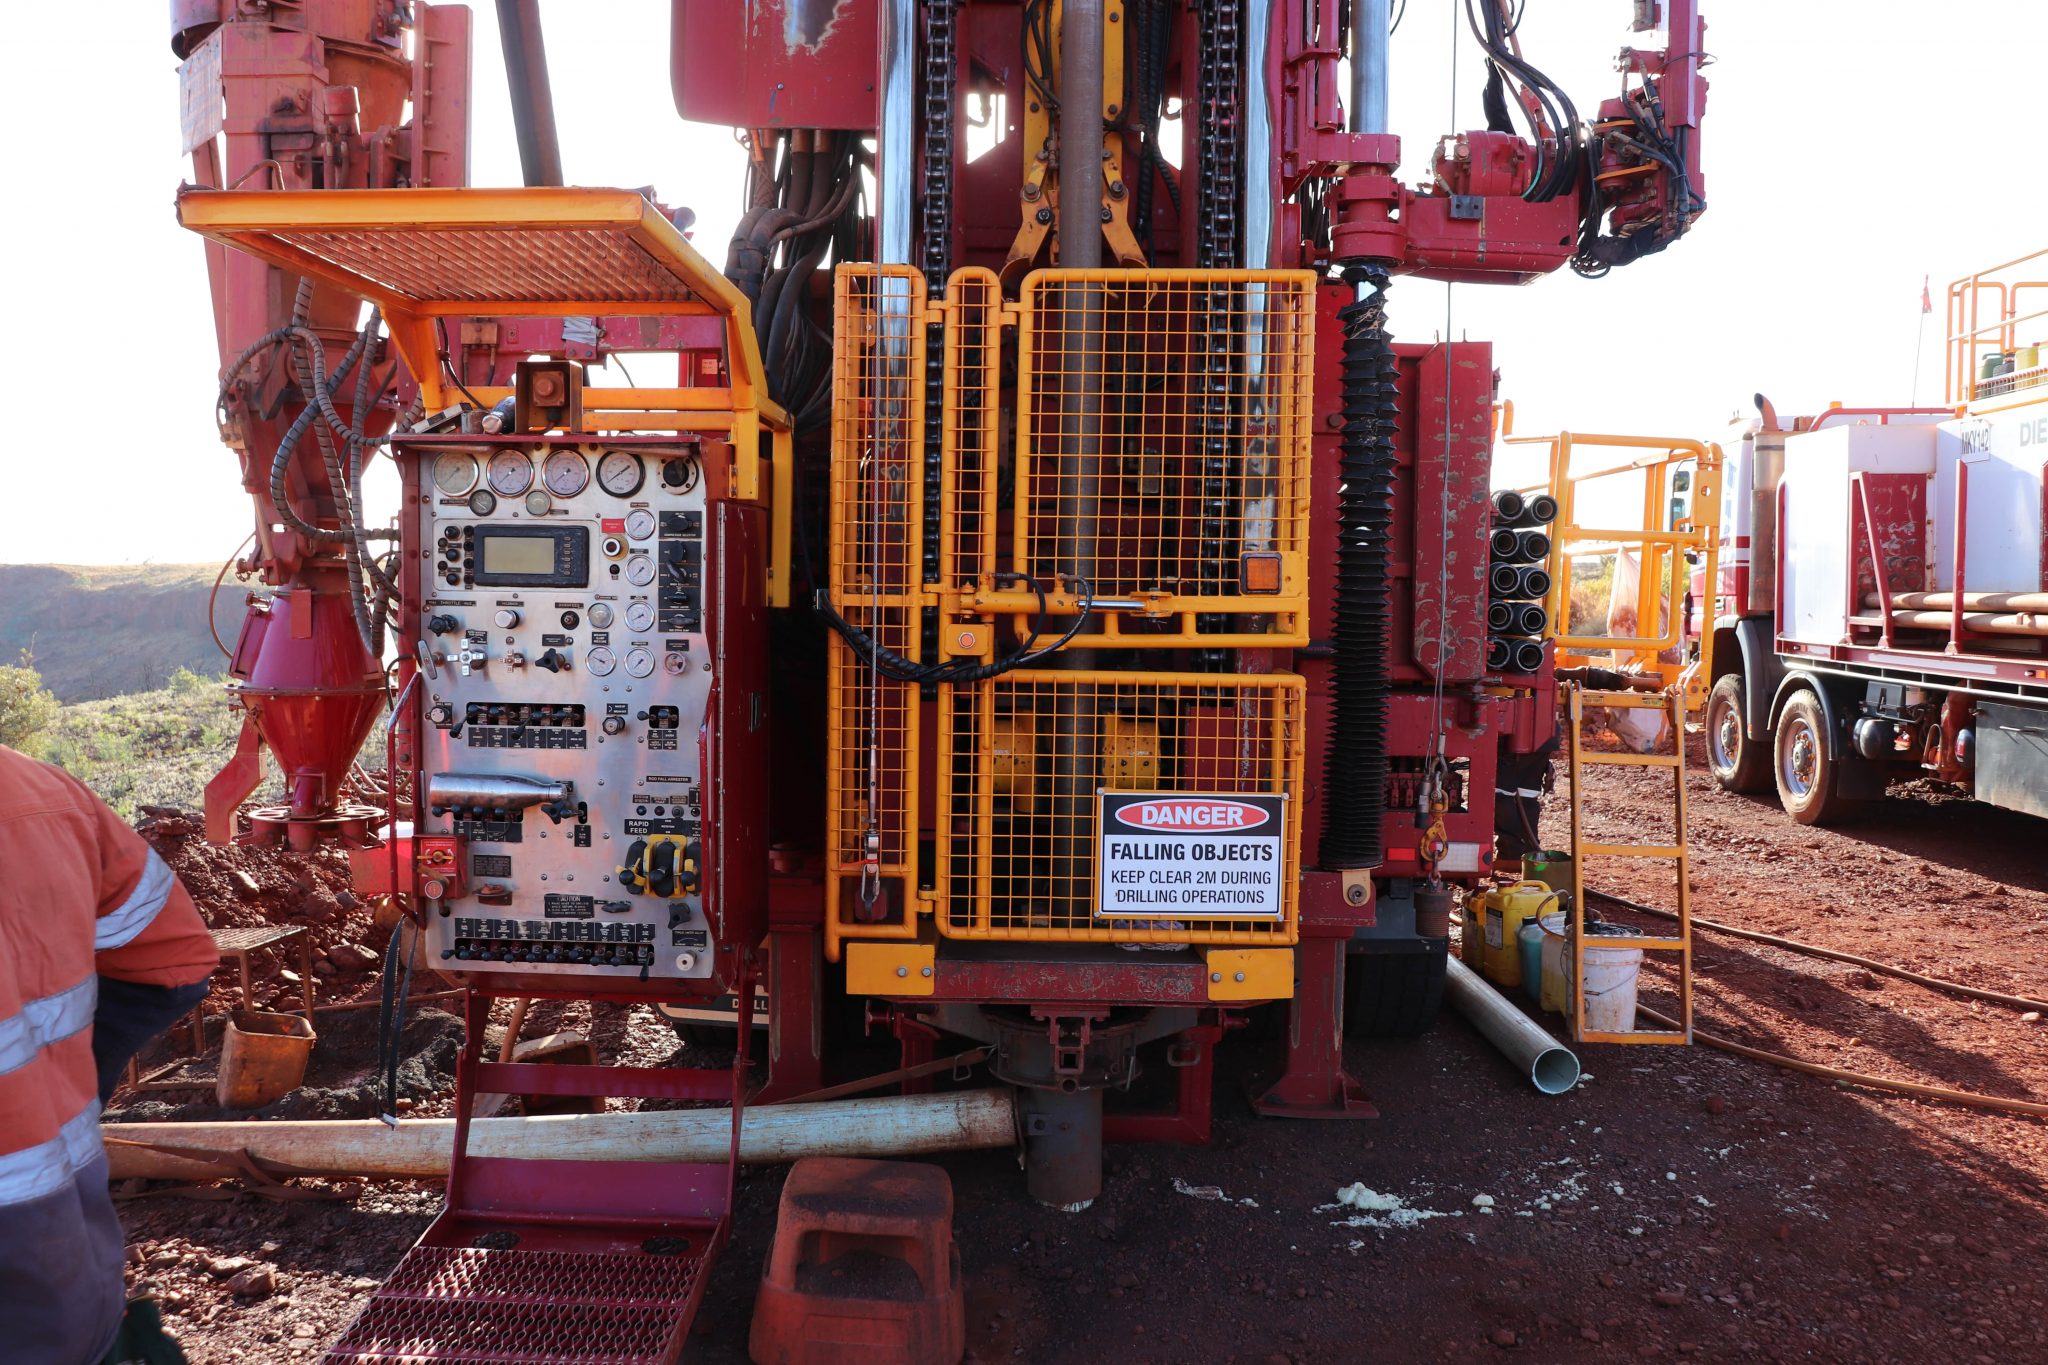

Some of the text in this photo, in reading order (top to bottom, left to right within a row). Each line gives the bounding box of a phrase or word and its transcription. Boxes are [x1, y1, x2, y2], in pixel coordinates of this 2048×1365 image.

[1961, 428, 1988, 454] MKY142
[2020, 418, 2047, 447] DIE
[1141, 806, 1244, 826] DANGER
[1111, 843, 1273, 861] FALLING OBJECTS
[1111, 870, 1271, 885] KEEP CLEAR 2M DURING
[1117, 890, 1265, 904] DRILLING OPERATIONS
[732, 998, 767, 1010] DLL
